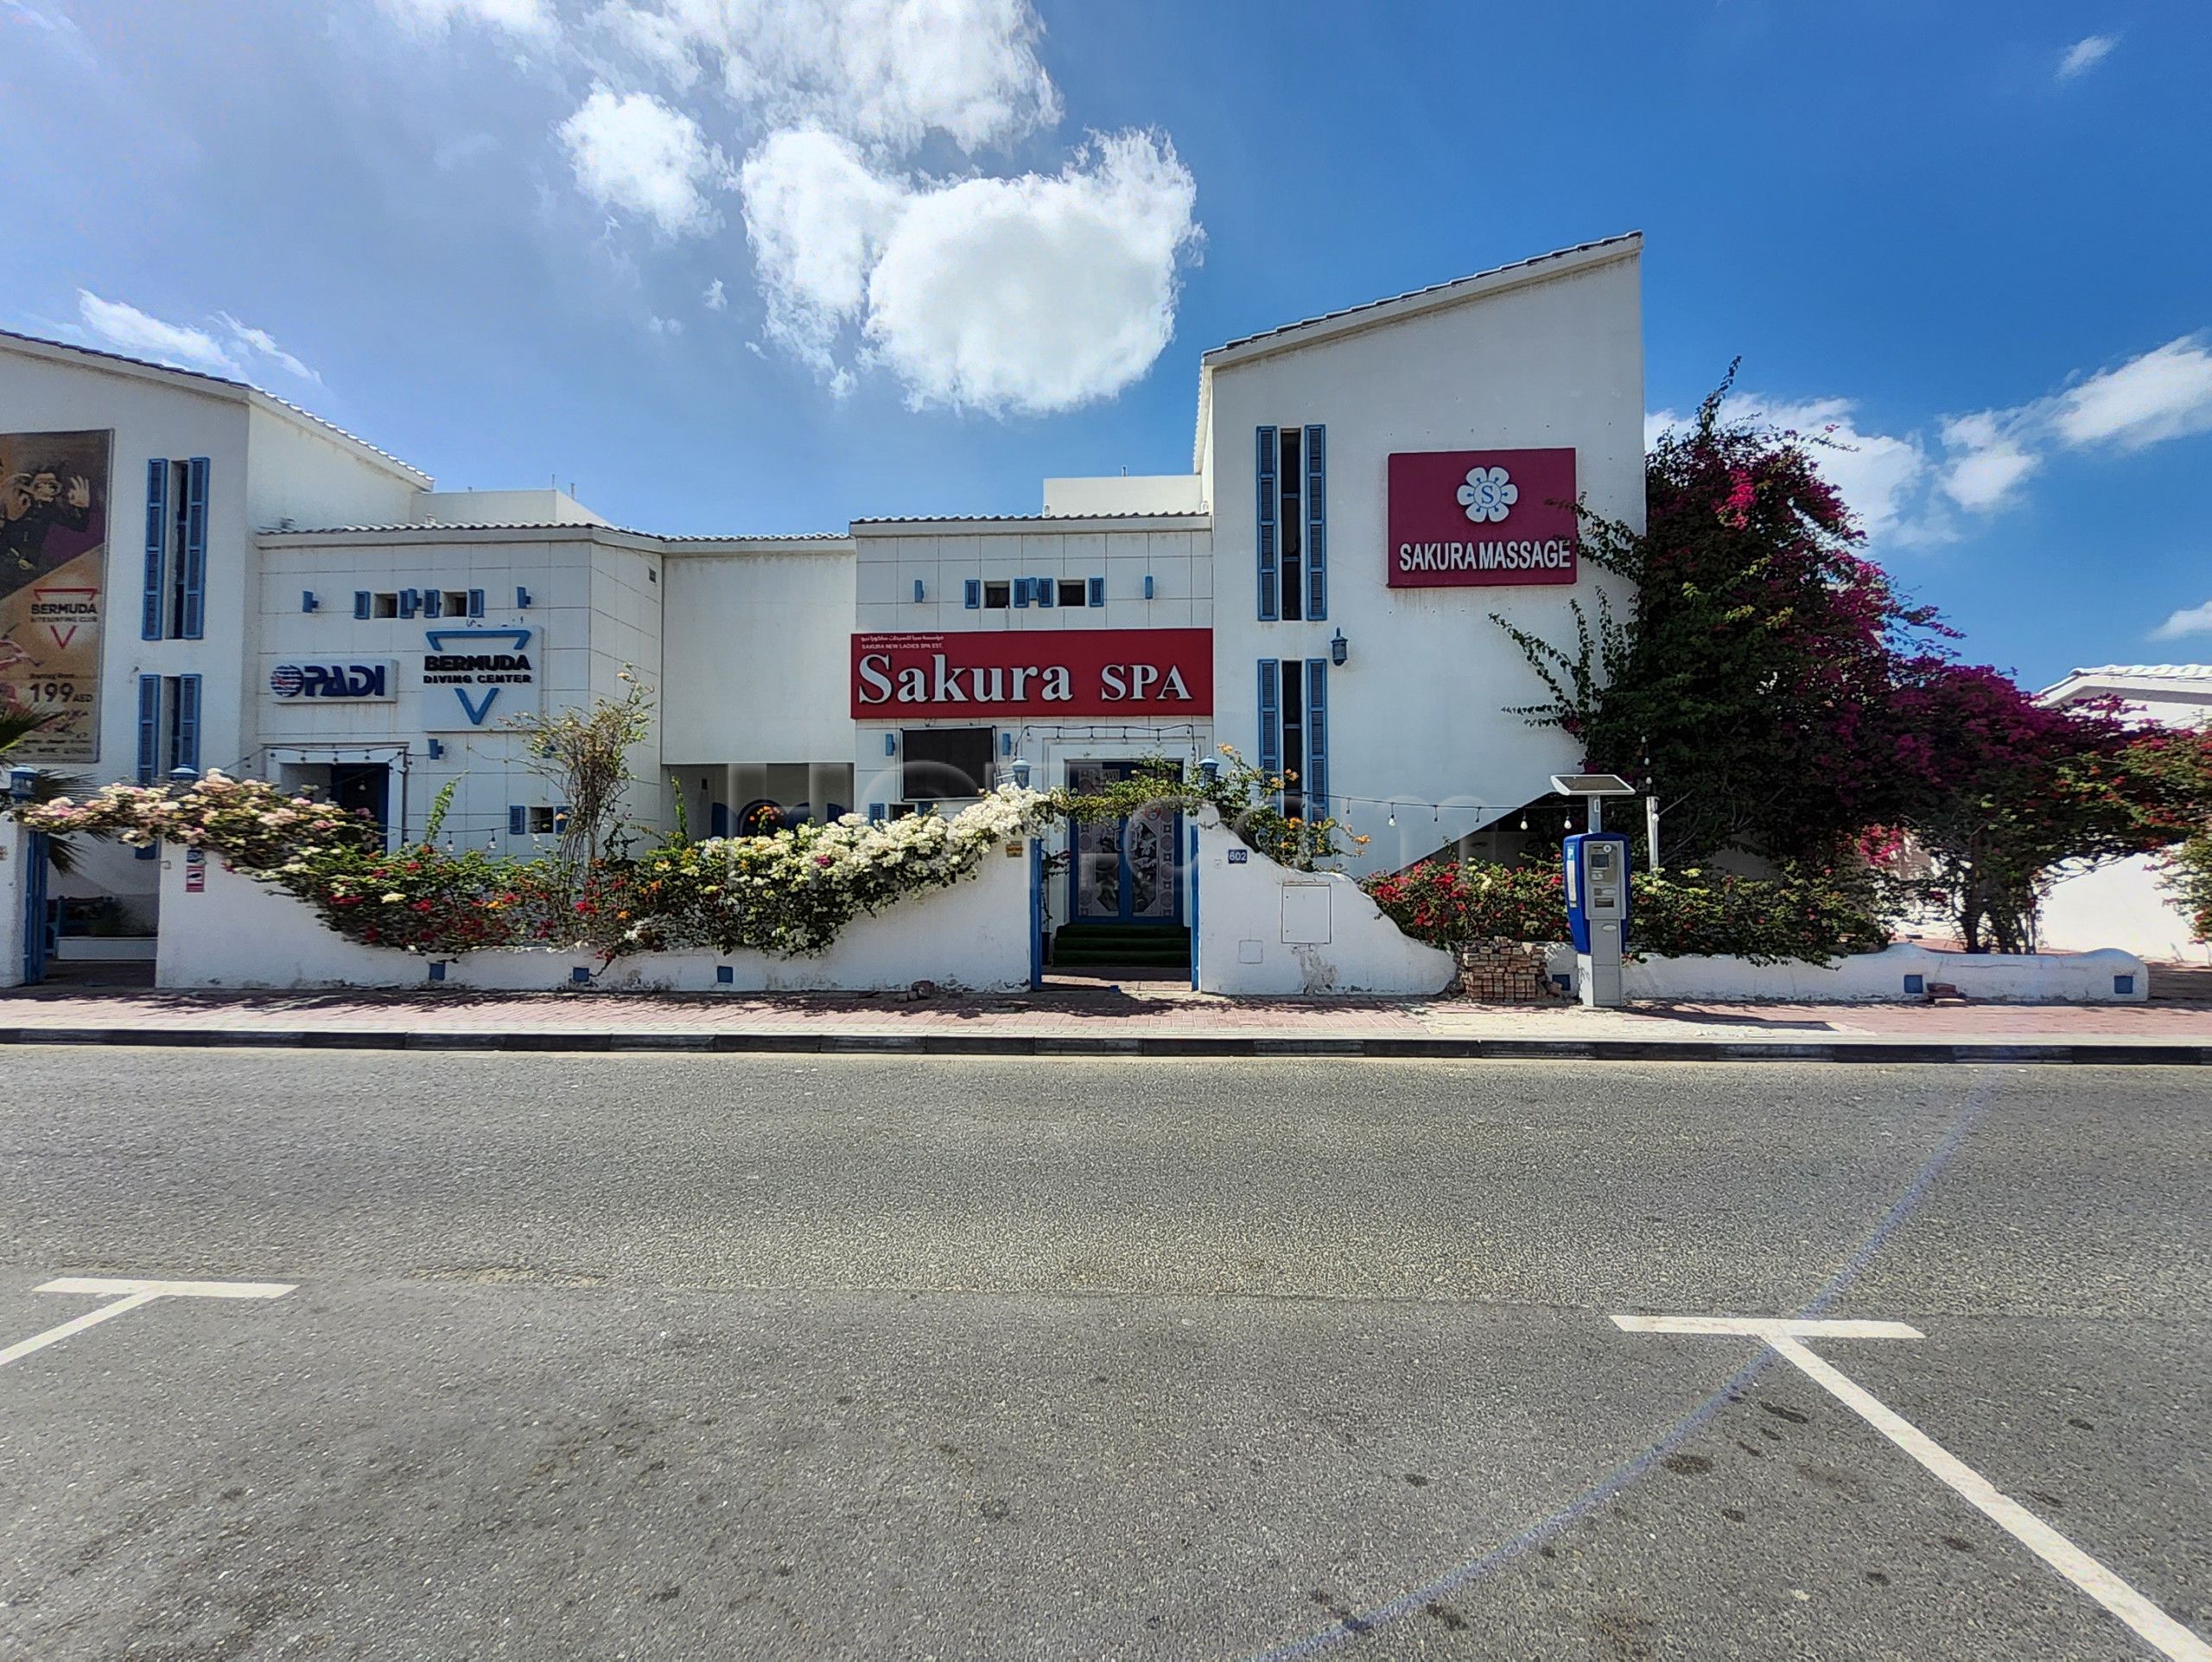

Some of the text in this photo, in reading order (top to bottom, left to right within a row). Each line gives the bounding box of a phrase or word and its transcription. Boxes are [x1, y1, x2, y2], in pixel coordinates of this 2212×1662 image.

[1480, 485, 1494, 504] S
[1400, 540, 1571, 570] SAKURA MASSAGE
[30, 603, 99, 614] BERMUDA
[423, 654, 532, 672] BERMUDA
[303, 664, 385, 697] PADI
[423, 673, 532, 684] DIVING CENTER
[857, 653, 1193, 704] Sakura SPA
[29, 682, 74, 703] 199
[1229, 851, 1247, 861] 602
